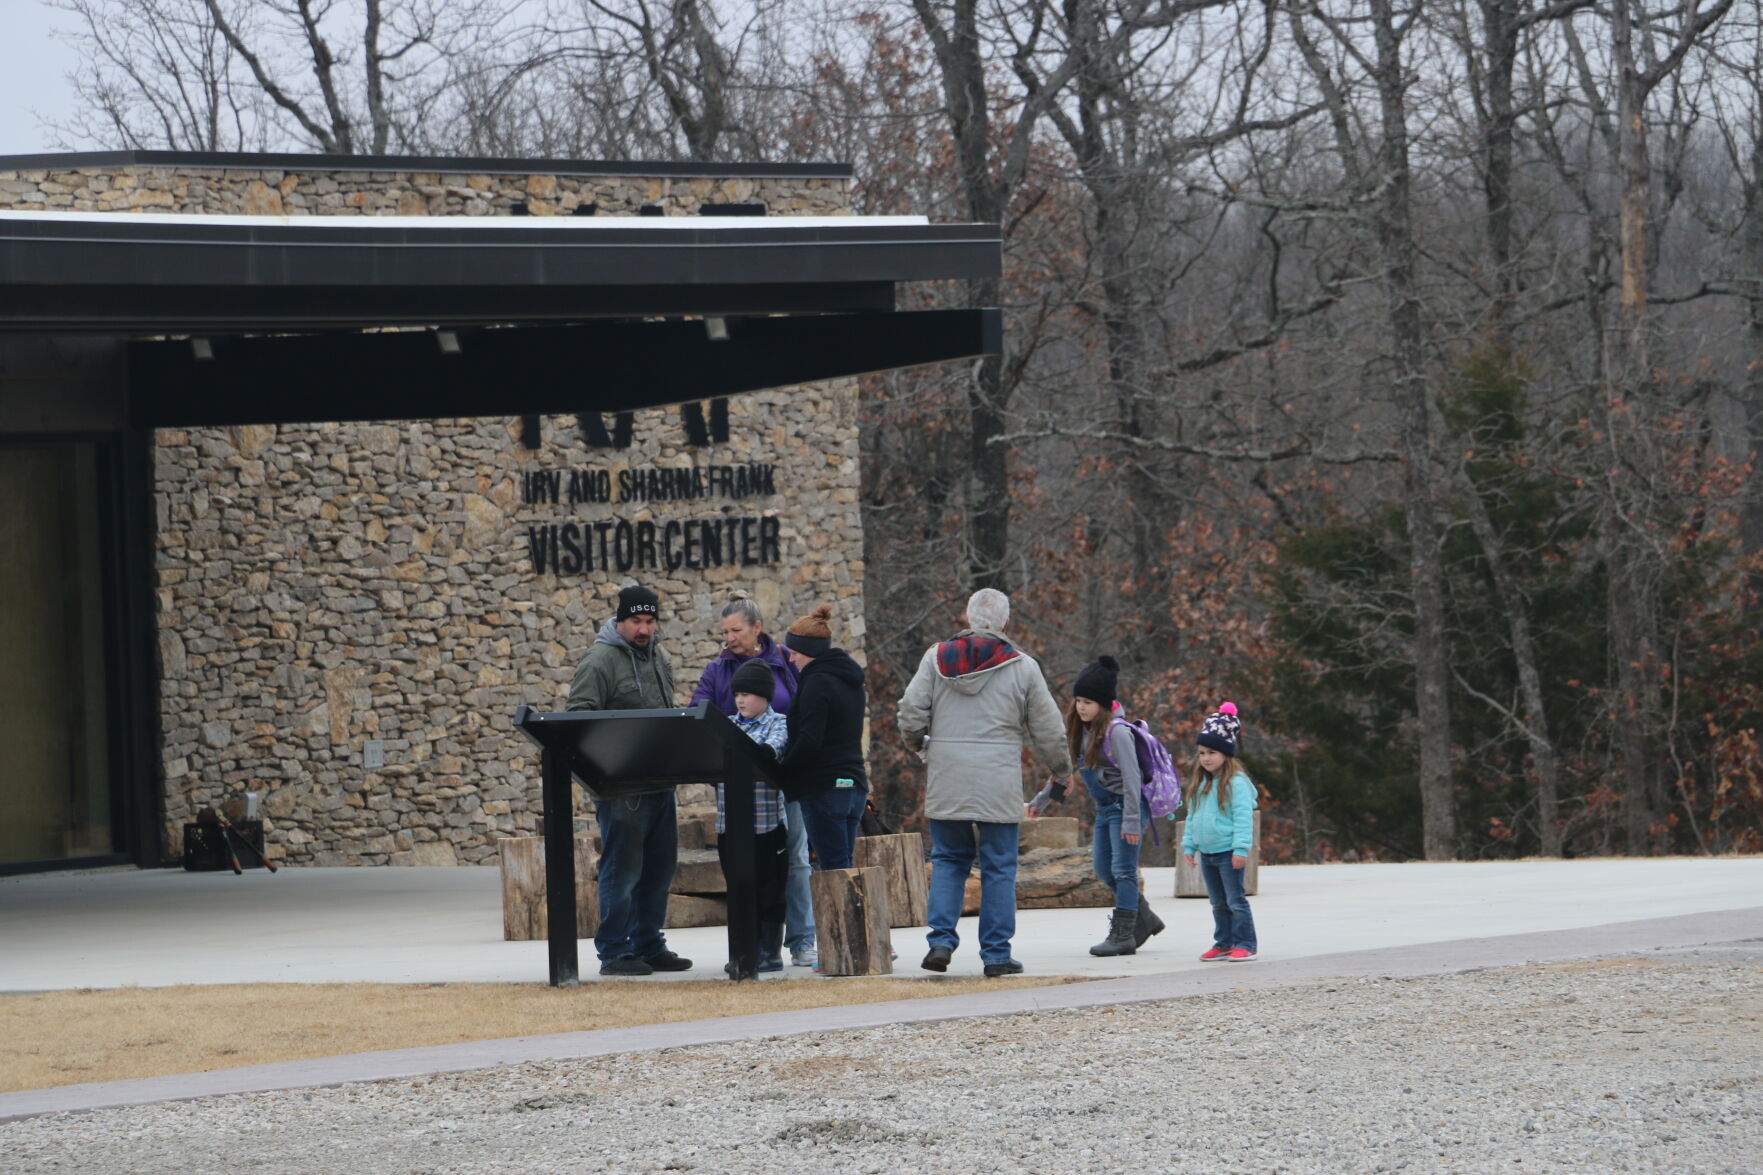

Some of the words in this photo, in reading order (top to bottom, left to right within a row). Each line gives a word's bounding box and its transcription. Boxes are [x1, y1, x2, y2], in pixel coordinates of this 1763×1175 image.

[525, 471, 561, 504] IRV
[569, 469, 612, 503] AND
[618, 466, 706, 501] SHARNA
[708, 463, 776, 497] FRANK
[529, 519, 657, 575] VISITOR
[664, 515, 780, 570] CENTER
[630, 604, 656, 613] USCG
